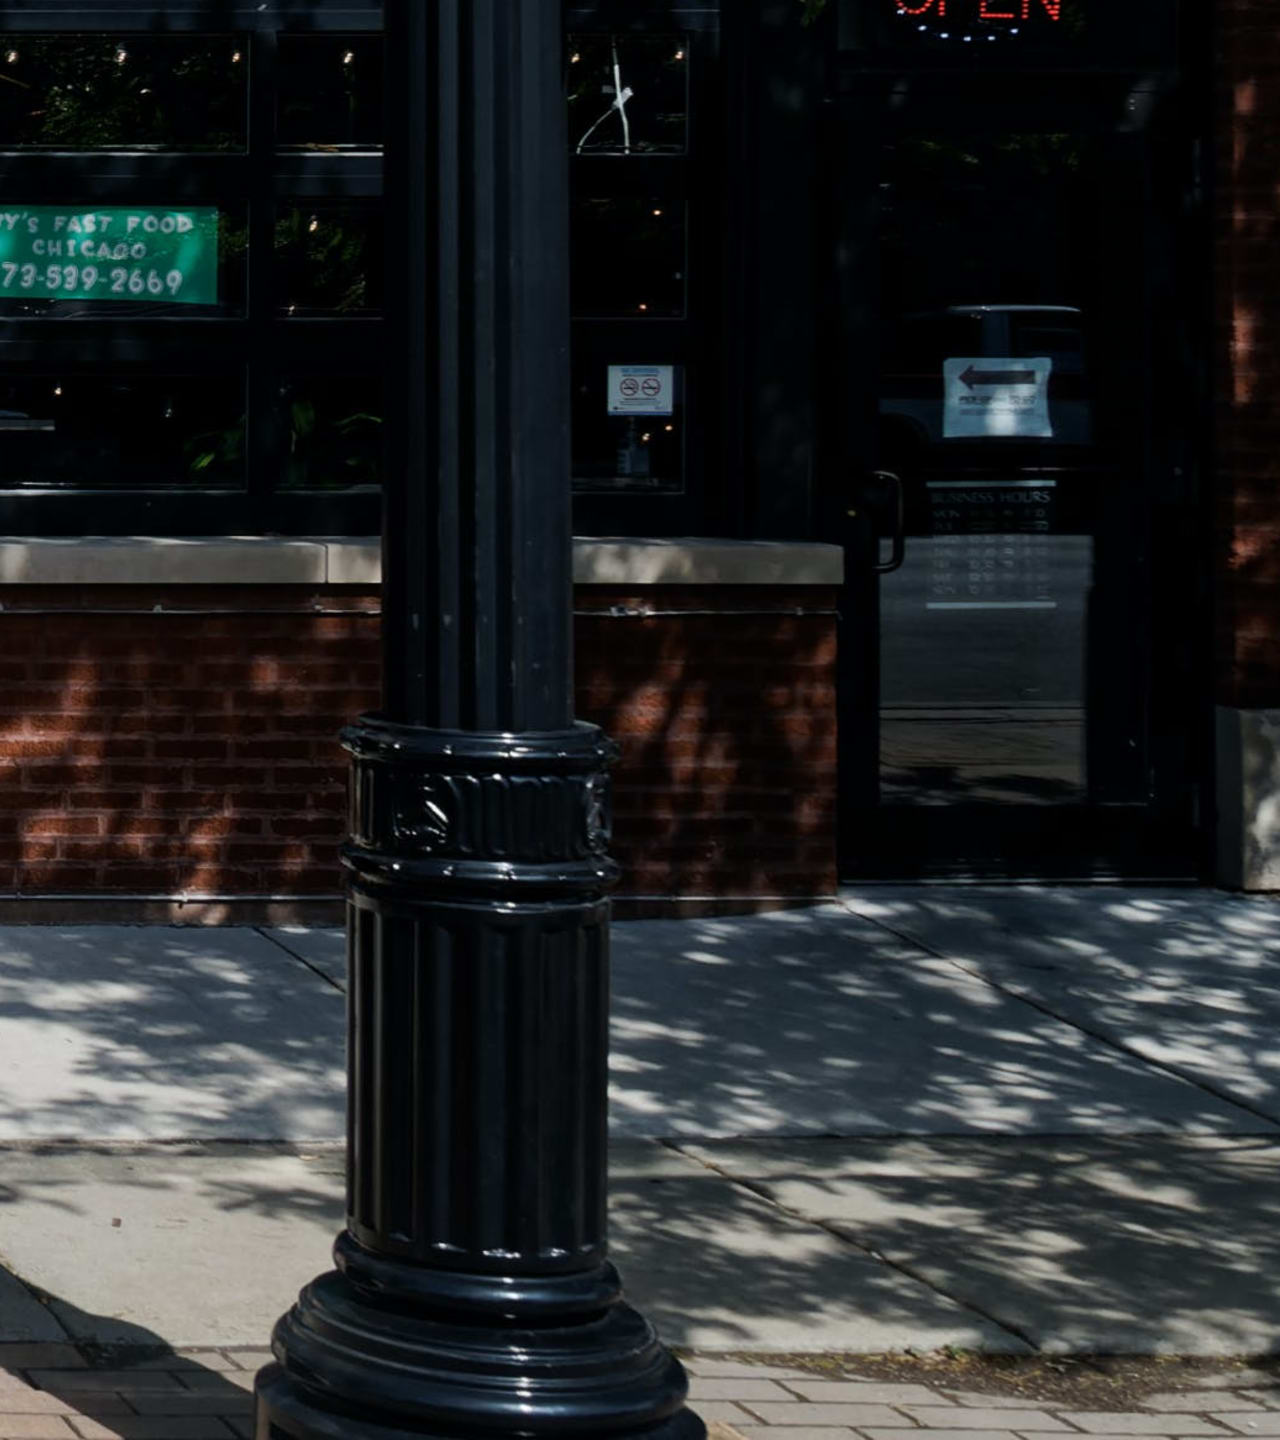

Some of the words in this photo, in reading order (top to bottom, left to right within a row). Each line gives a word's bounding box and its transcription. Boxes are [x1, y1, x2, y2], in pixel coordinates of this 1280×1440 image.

[53, 214, 113, 233] FAST
[126, 214, 194, 234] FOOD
[32, 239, 146, 259] CHICAGO
